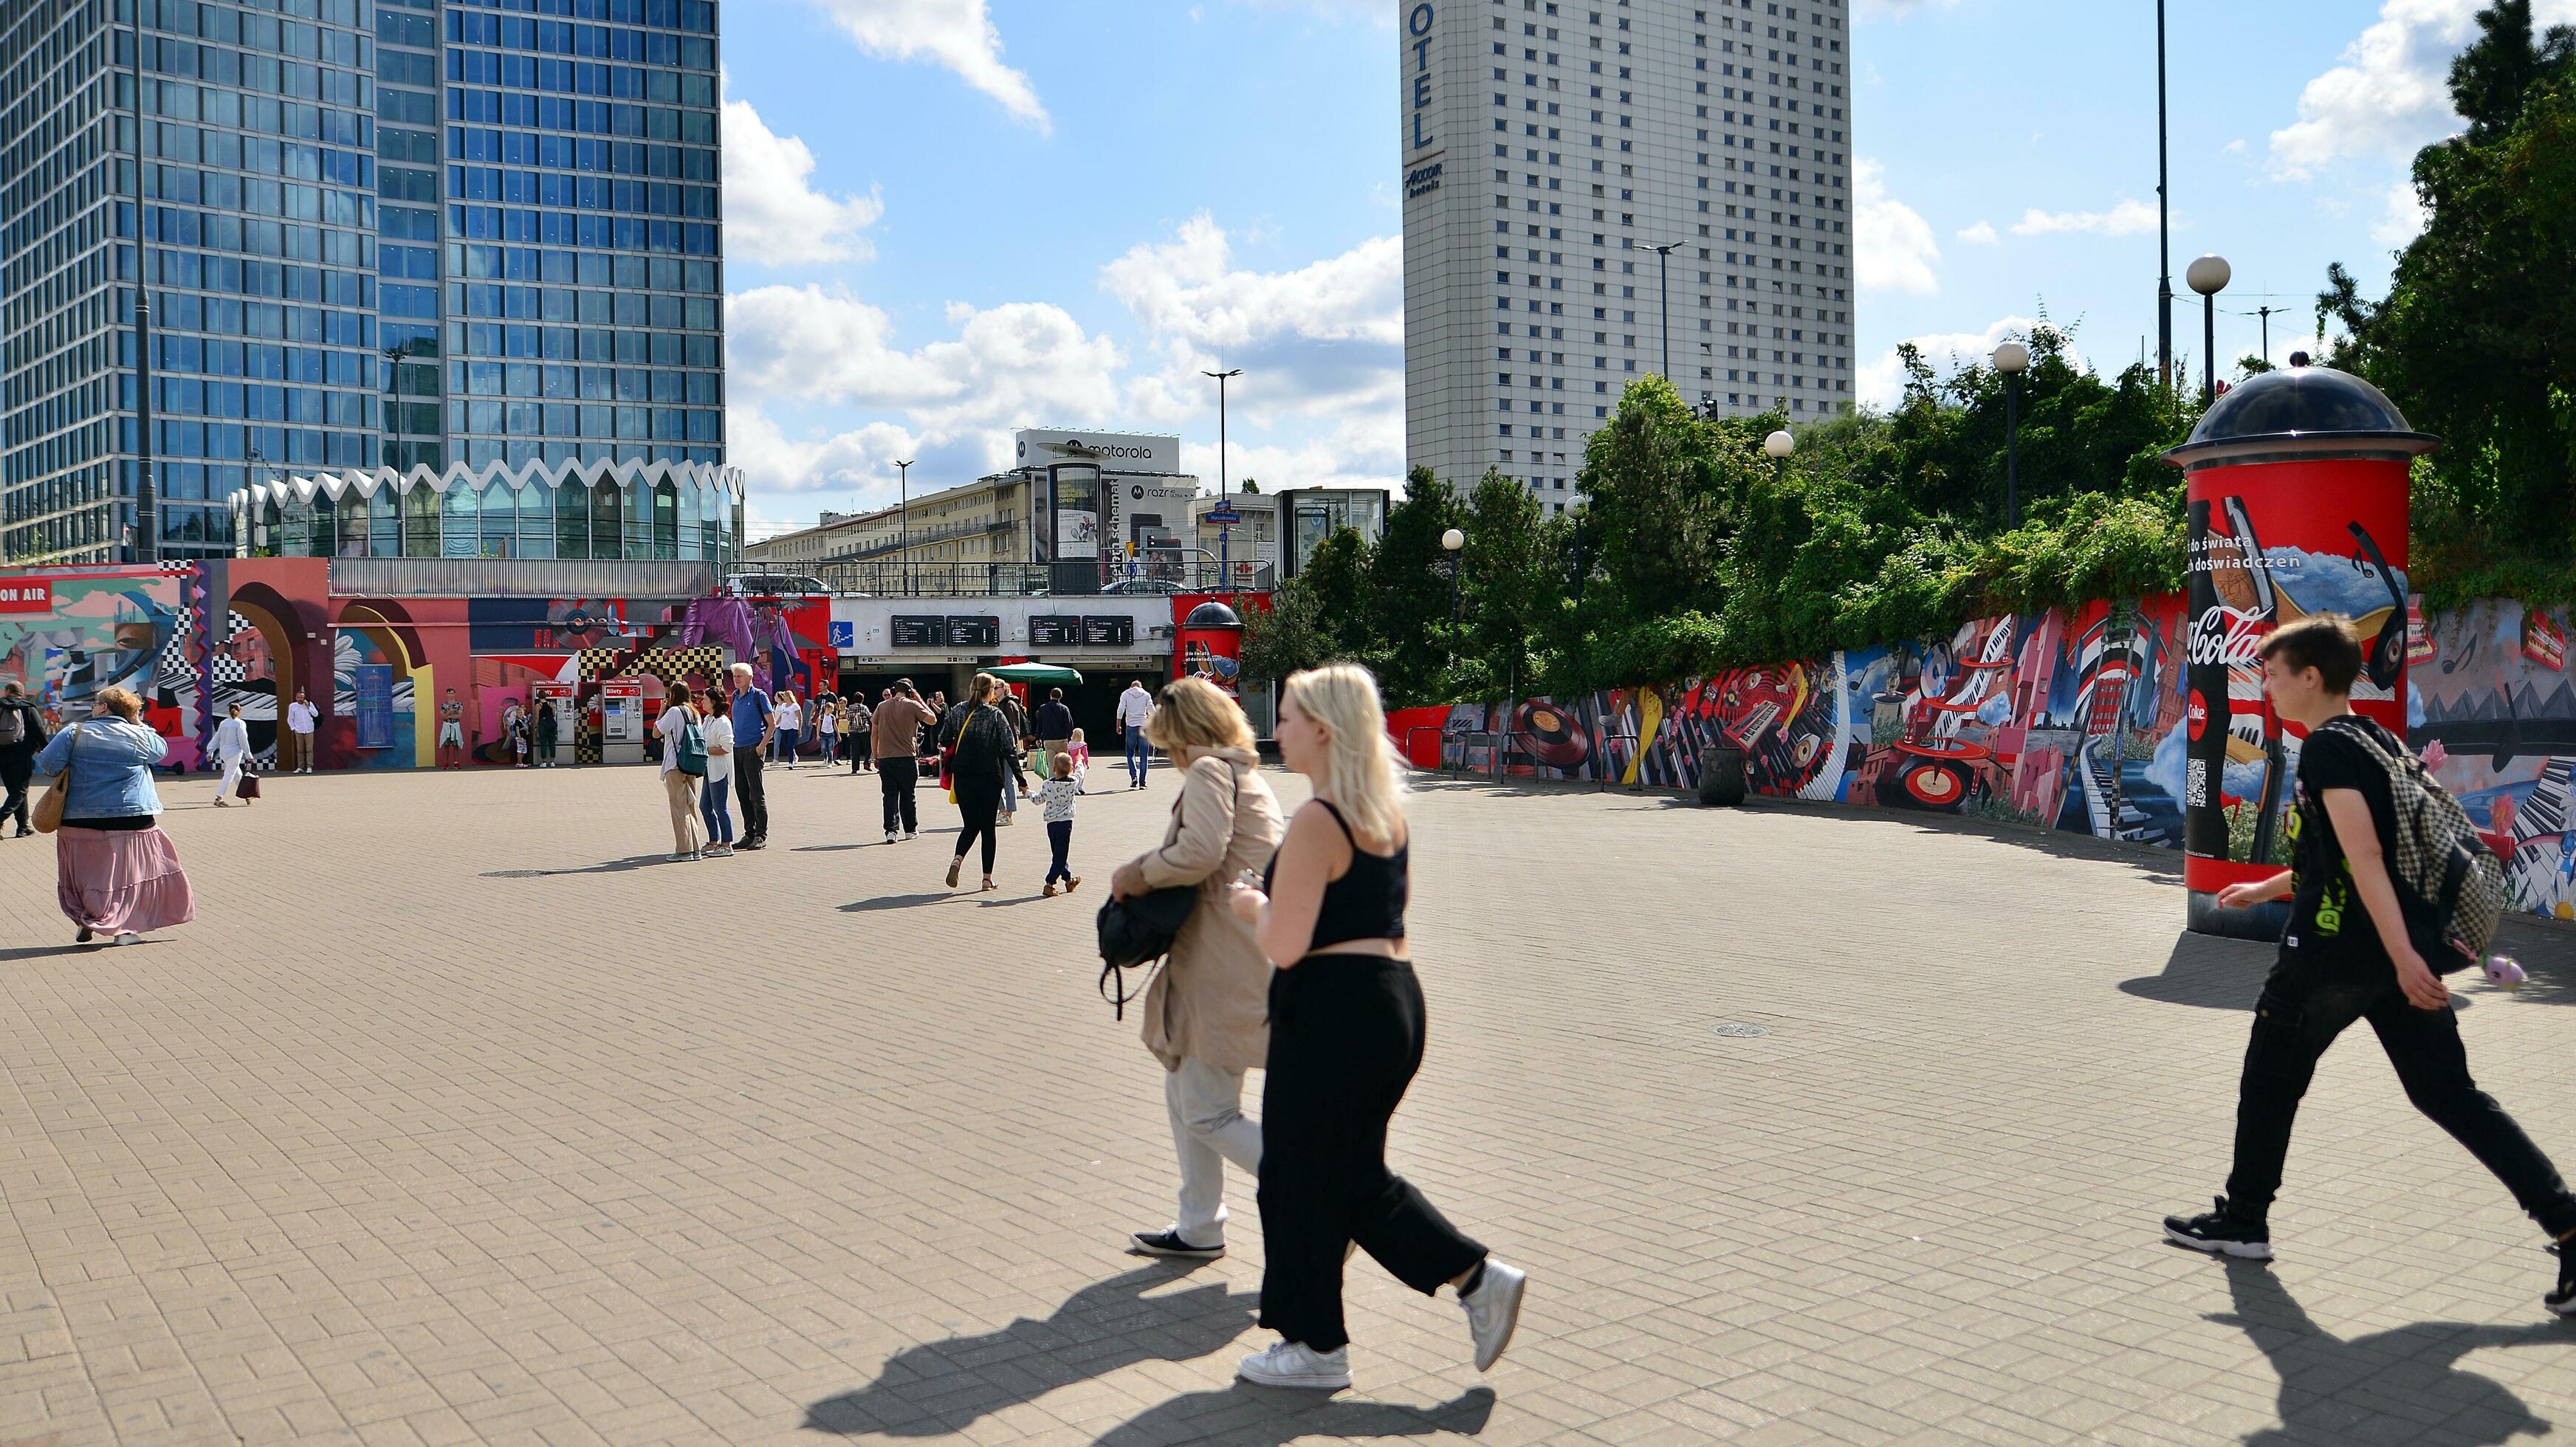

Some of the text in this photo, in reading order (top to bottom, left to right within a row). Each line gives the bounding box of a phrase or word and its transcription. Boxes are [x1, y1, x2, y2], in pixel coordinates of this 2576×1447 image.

[1409, 3, 1434, 150] OTEL
[1409, 179, 1440, 198] hotels
[1088, 444, 1152, 459] motorola
[1147, 489, 1169, 498] razr
[1109, 478, 1120, 539] schemat
[2191, 535, 2252, 553] do świata
[2195, 553, 2301, 572] doświadczeń
[0, 588, 46, 602] ON AIR
[2188, 704, 2206, 720] Coke
